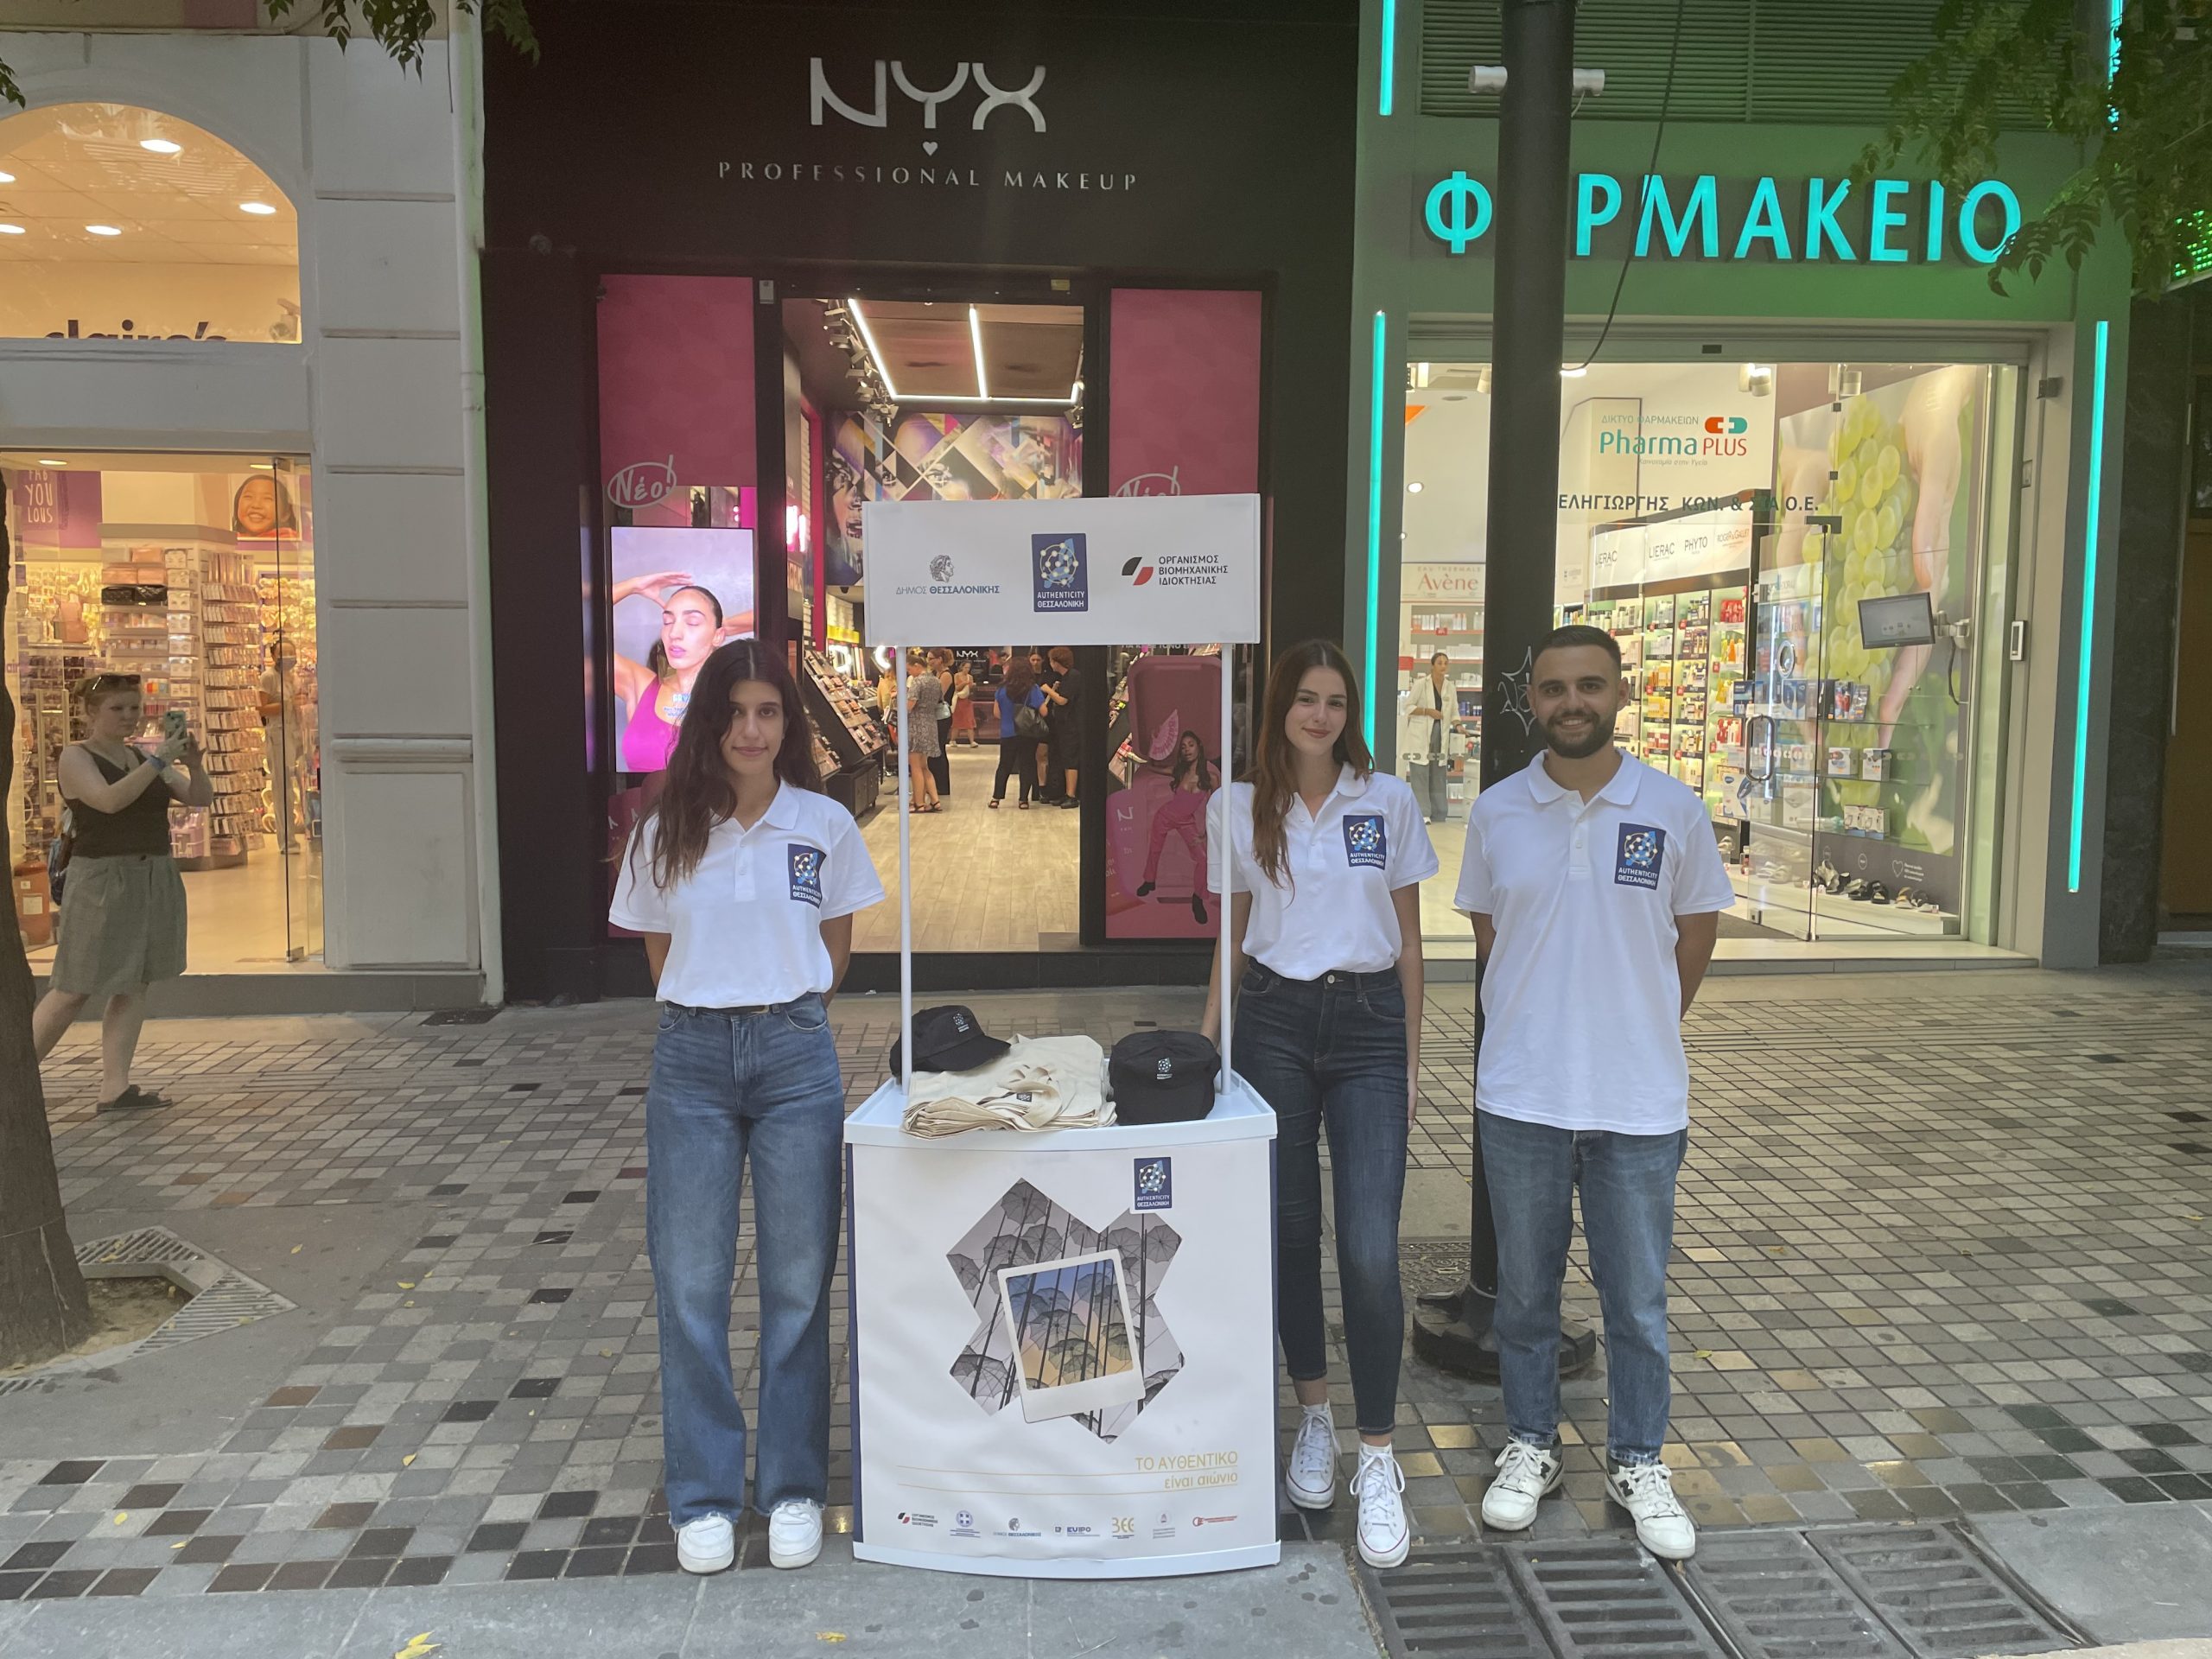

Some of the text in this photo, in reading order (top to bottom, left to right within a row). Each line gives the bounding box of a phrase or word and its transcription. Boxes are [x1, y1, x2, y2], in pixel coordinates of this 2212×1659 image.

[810, 57, 1046, 132] NYX
[719, 162, 1136, 190] PROFESSIONAL MAKEUP
[1425, 171, 2022, 264] ΦΡΜΑΚΕΙΟ
[1601, 415, 1634, 423] ΔΙΚΤΥΟ
[1599, 429, 1747, 456] Pharma PLUS
[25, 482, 54, 506] YOU
[1682, 497, 1724, 511] ΚΩΝ.
[1731, 496, 1742, 511] &
[1785, 497, 1819, 511] Ο.Ε.
[28, 506, 54, 523] LOUS
[1649, 543, 1675, 559] LIERAC
[1685, 537, 1708, 551] PHYTO
[1159, 555, 1219, 564] ΟΡΓΑΝΙΣΜΟΣ
[1159, 565, 1229, 575] ΒΙΟΜΗΧΑΝΙΚΗΣ
[1159, 576, 1217, 585] ΙΔΙΟΚΤΗΣΙΑΣ
[1418, 573, 1478, 590] Avène
[929, 585, 1000, 594] ΘΕΣΣΑΛΟΝΙΚΗΣ
[1135, 1451, 1238, 1471] ΤΟ ΑΥΘΕΝΤΙΚΟ
[1165, 1471, 1238, 1489] είναι αιώνιο
